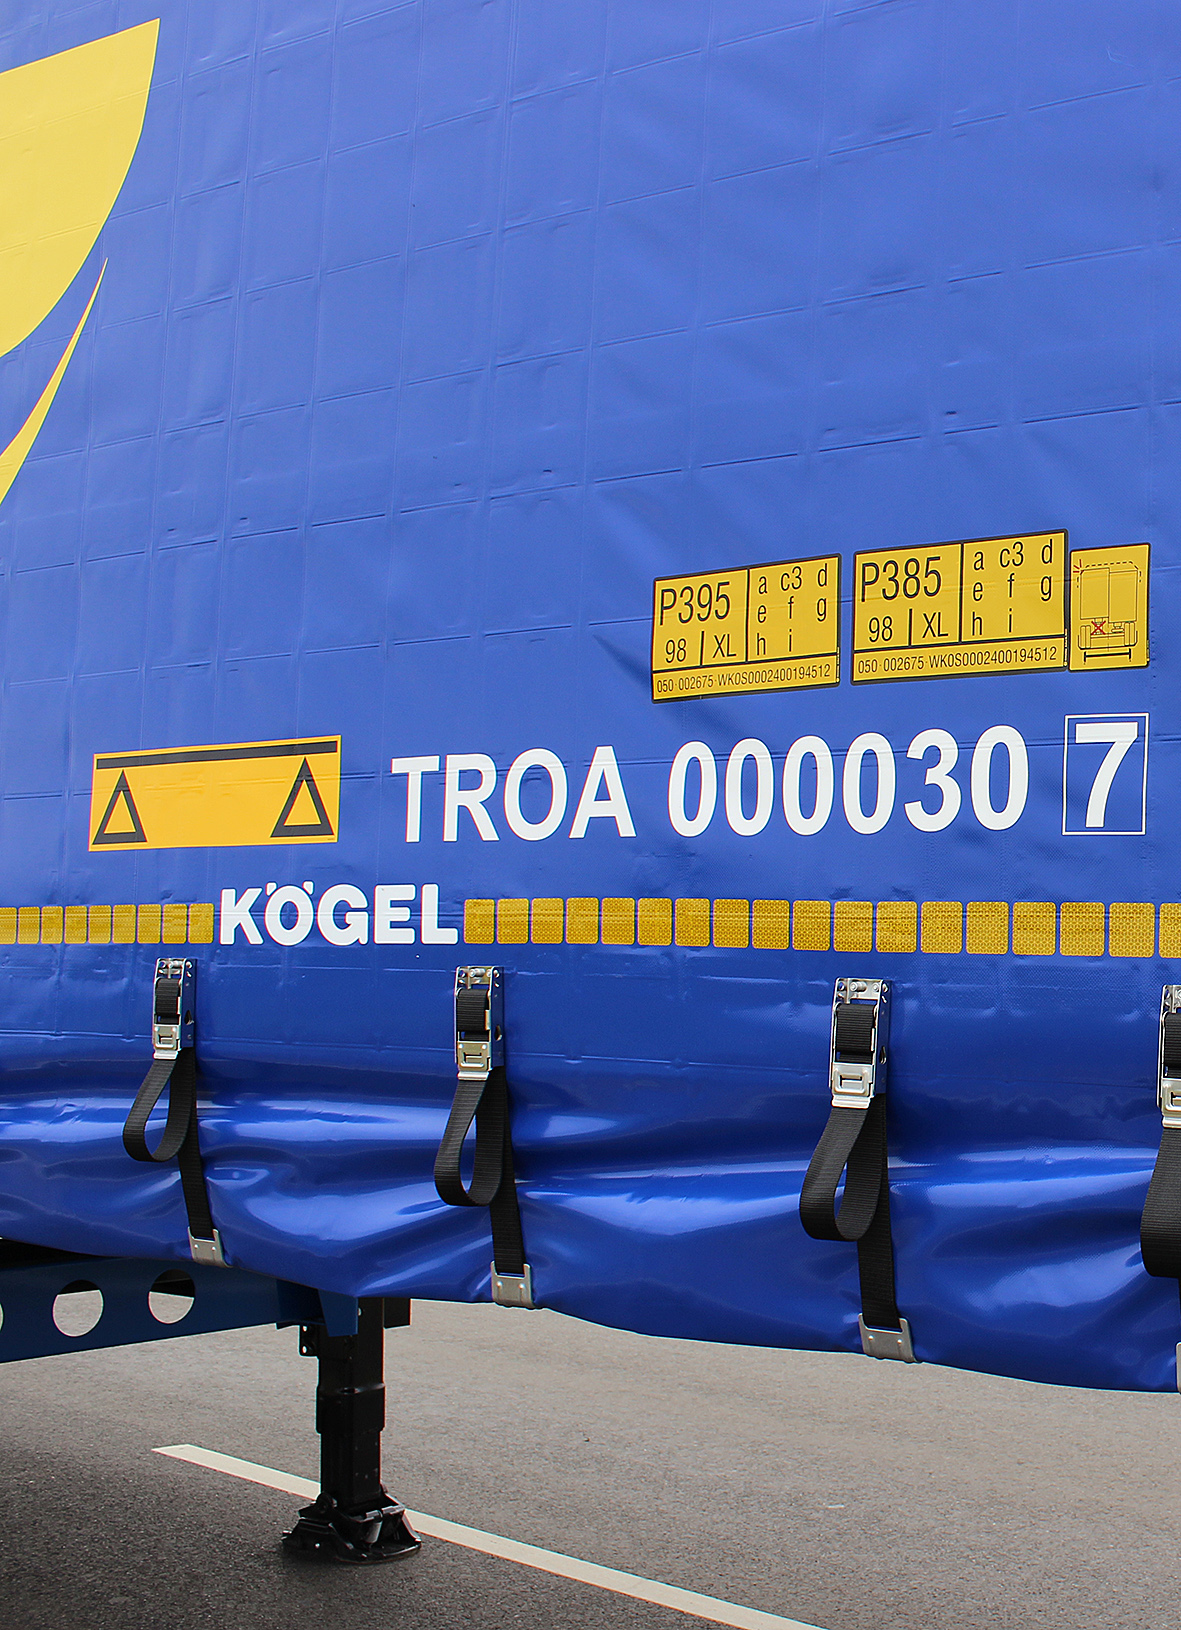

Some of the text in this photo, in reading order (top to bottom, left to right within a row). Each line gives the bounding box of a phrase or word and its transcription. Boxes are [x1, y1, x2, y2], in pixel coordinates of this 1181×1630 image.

[973, 538, 1053, 571] a c3 d
[758, 562, 828, 594] a c3 d
[861, 556, 942, 602] P385
[972, 572, 1052, 602] e f g
[659, 581, 731, 626] P395
[757, 595, 827, 624] e f g
[868, 611, 949, 643] 98 XL
[971, 607, 1013, 636] h i
[665, 633, 737, 663] 98 XL
[756, 628, 793, 656] h i
[391, 721, 1139, 843] TROA 000030 7
[219, 881, 459, 946] KÖGEL
